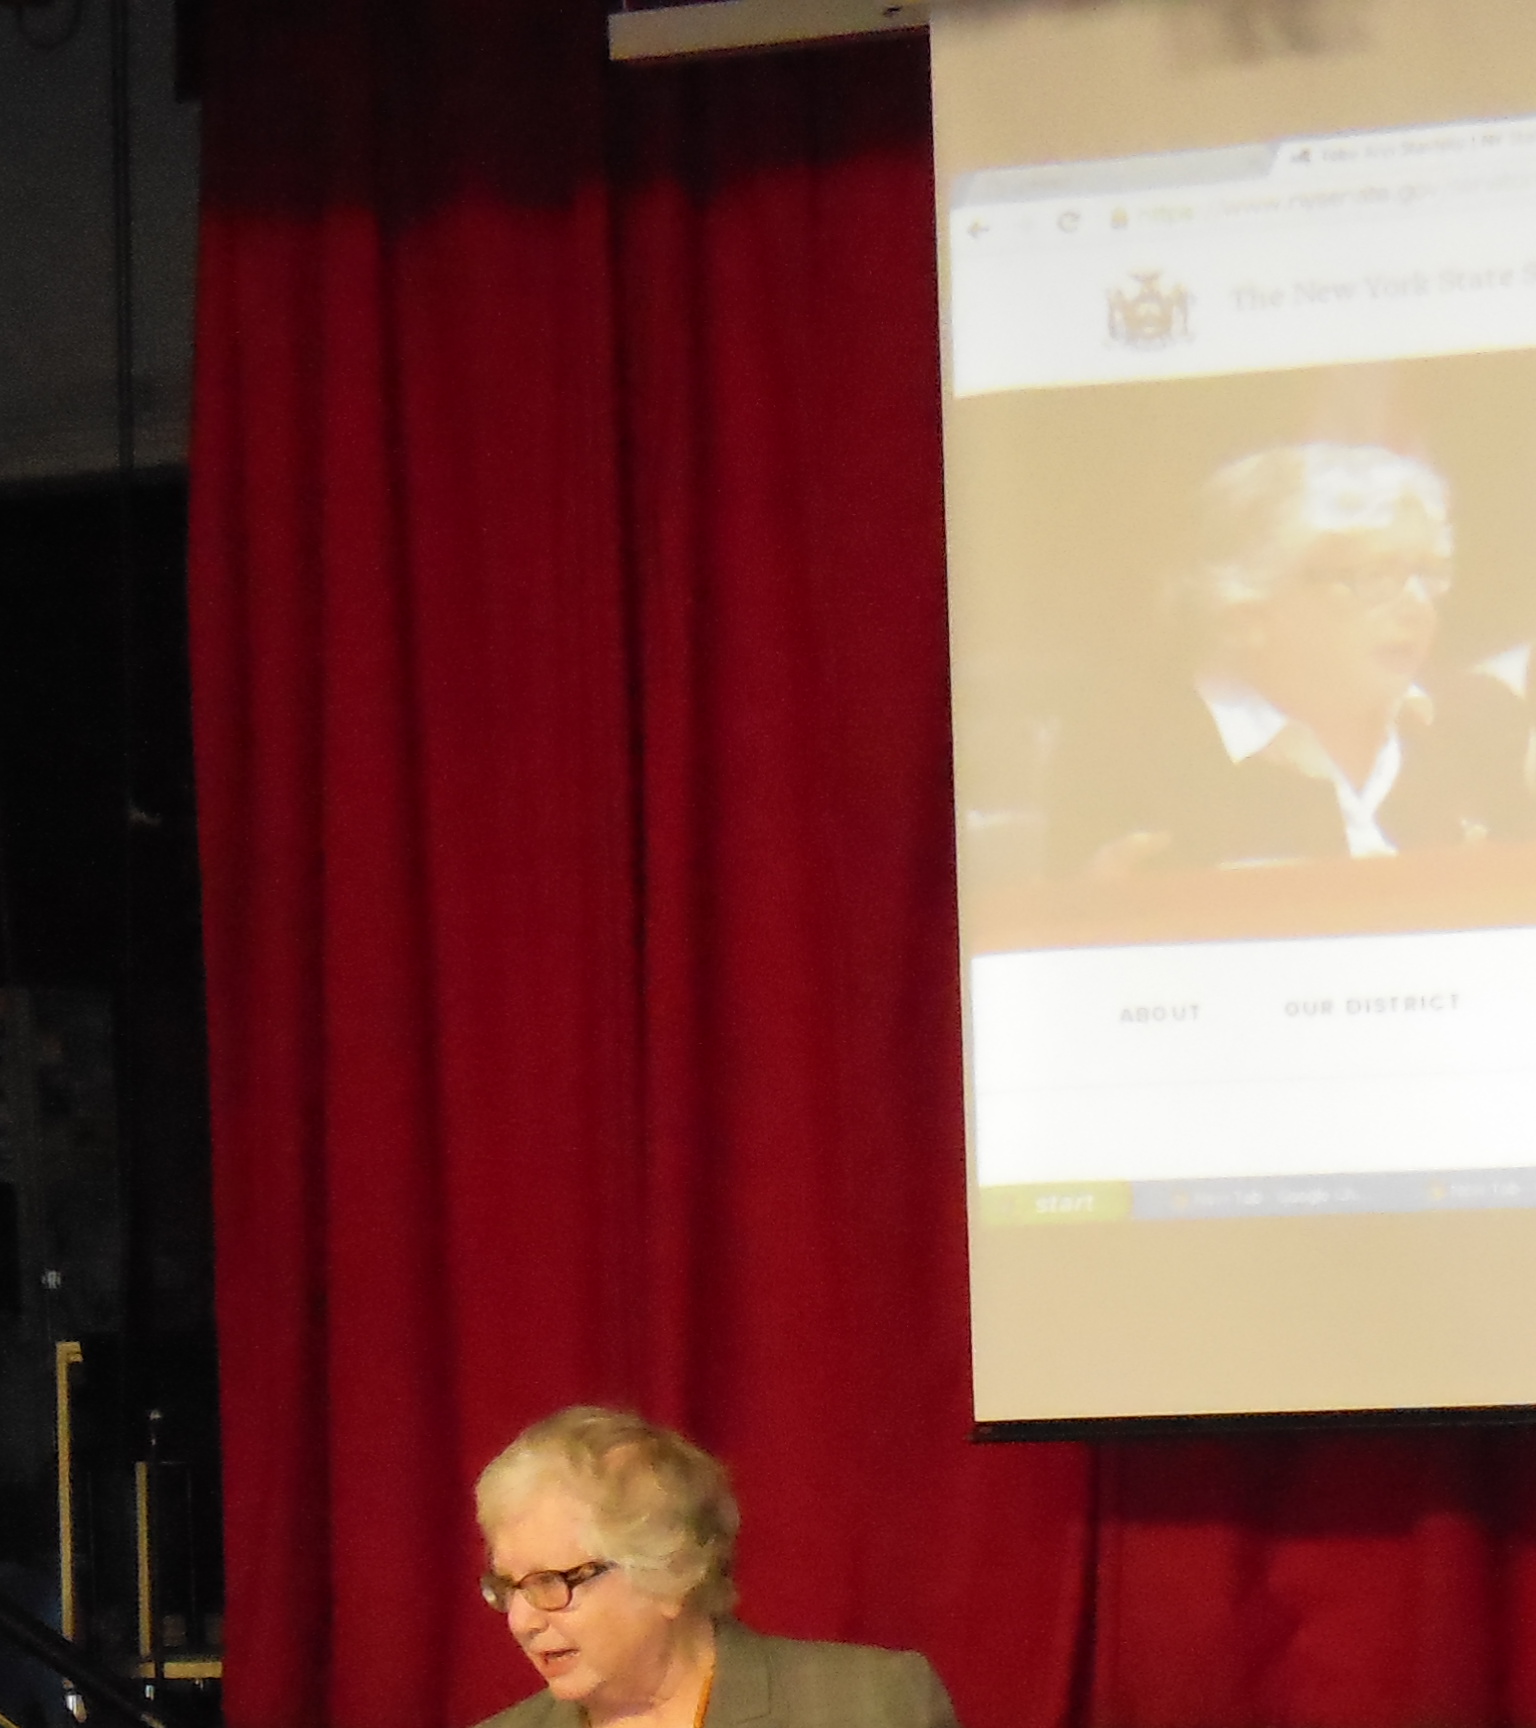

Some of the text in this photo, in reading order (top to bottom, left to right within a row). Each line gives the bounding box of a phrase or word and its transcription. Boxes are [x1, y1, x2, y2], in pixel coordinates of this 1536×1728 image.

[1231, 279, 1286, 311] The
[1292, 276, 1357, 306] New
[1363, 270, 1430, 301] York
[1436, 265, 1514, 294] State
[1118, 1002, 1202, 1024] ABOUT
[1283, 1000, 1334, 1018] OUR
[1344, 992, 1460, 1017] DISTRICT
[1033, 1191, 1095, 1214] start
